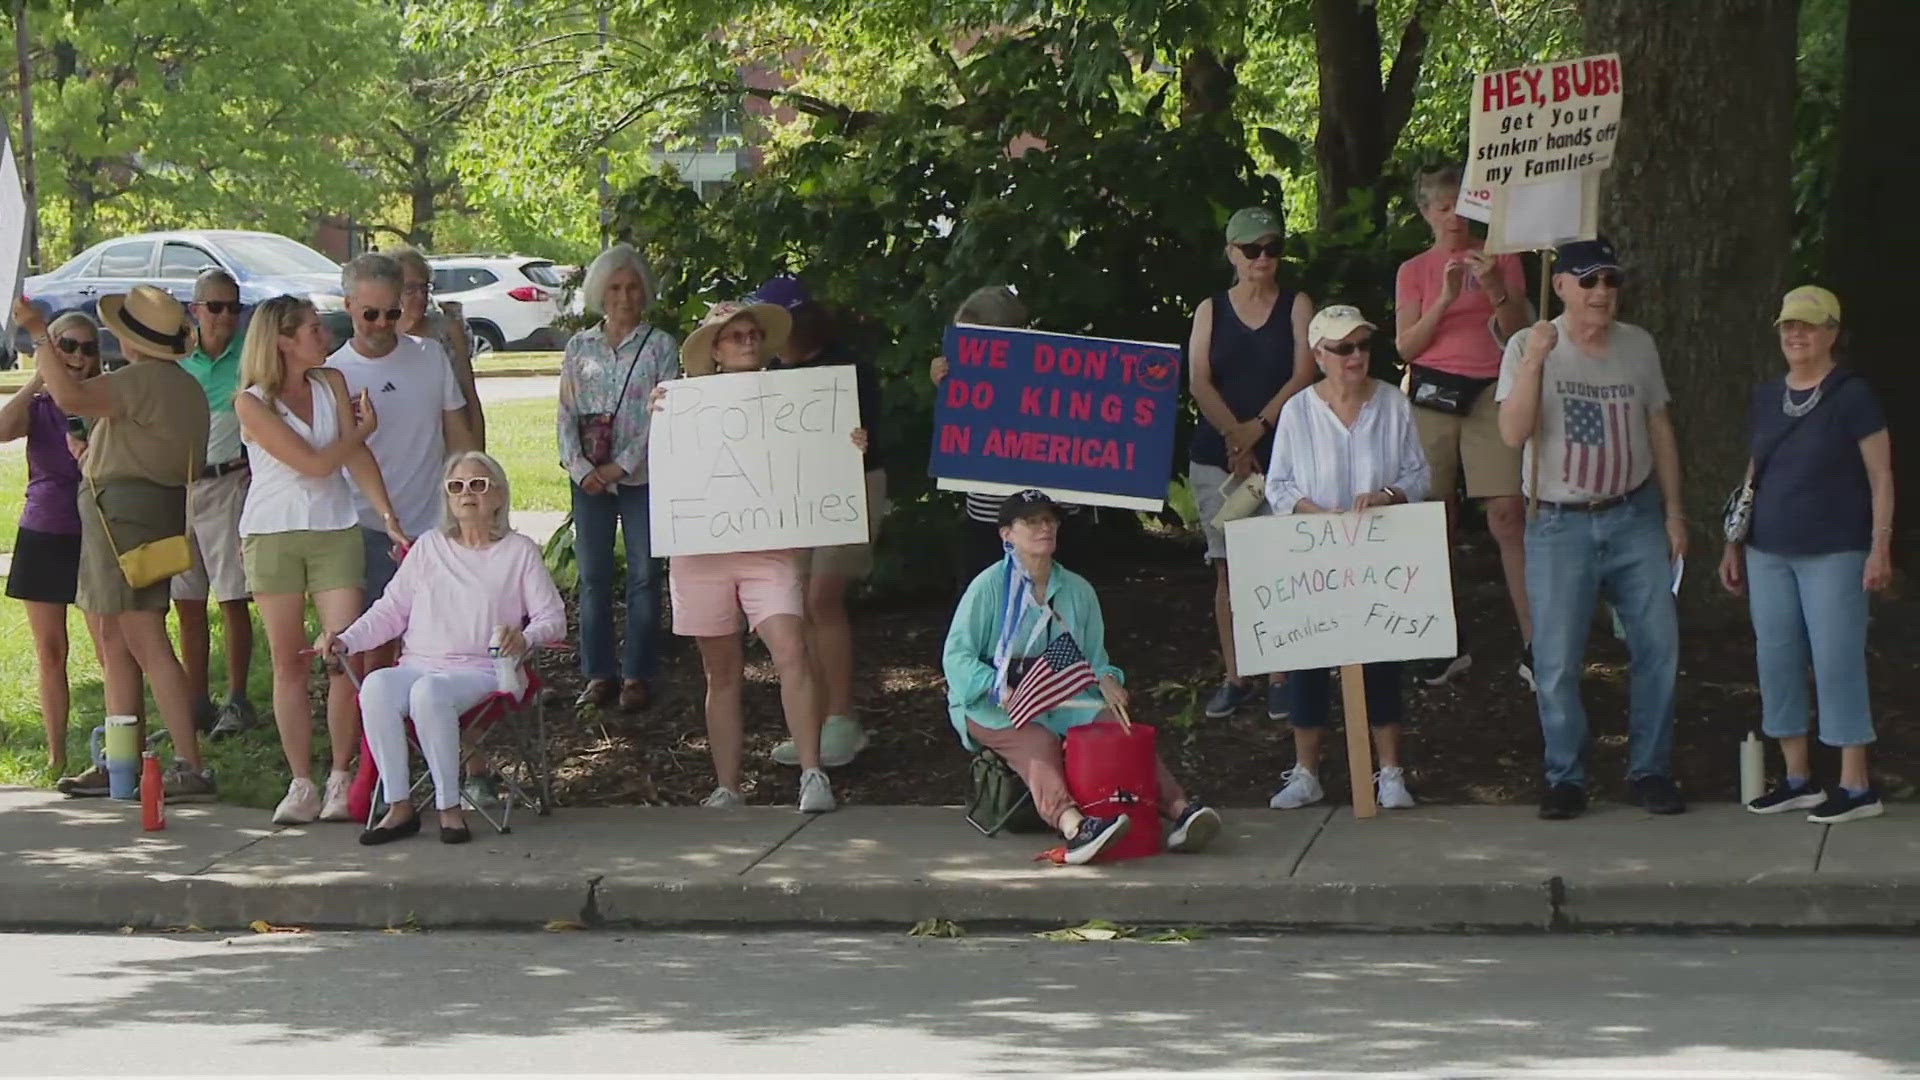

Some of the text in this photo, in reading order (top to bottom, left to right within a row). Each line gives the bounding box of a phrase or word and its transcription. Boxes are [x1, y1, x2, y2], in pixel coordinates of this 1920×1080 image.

[1482, 58, 1620, 112] HEY, BUB!
[1501, 105, 1600, 134] get your
[1596, 122, 1617, 142] off
[1486, 166, 1512, 185] my
[958, 335, 1138, 384] WE DON'T
[946, 379, 1156, 426] DO KINGS
[1556, 380, 1635, 399] LUDINGTON
[669, 377, 848, 456] Protect
[702, 441, 801, 498] All
[939, 424, 1135, 471] IN AMERICA!
[670, 494, 859, 544] Families
[1289, 513, 1386, 553] SAVE
[1254, 566, 1419, 610] DEMOCRACY
[1252, 618, 1340, 657] Families
